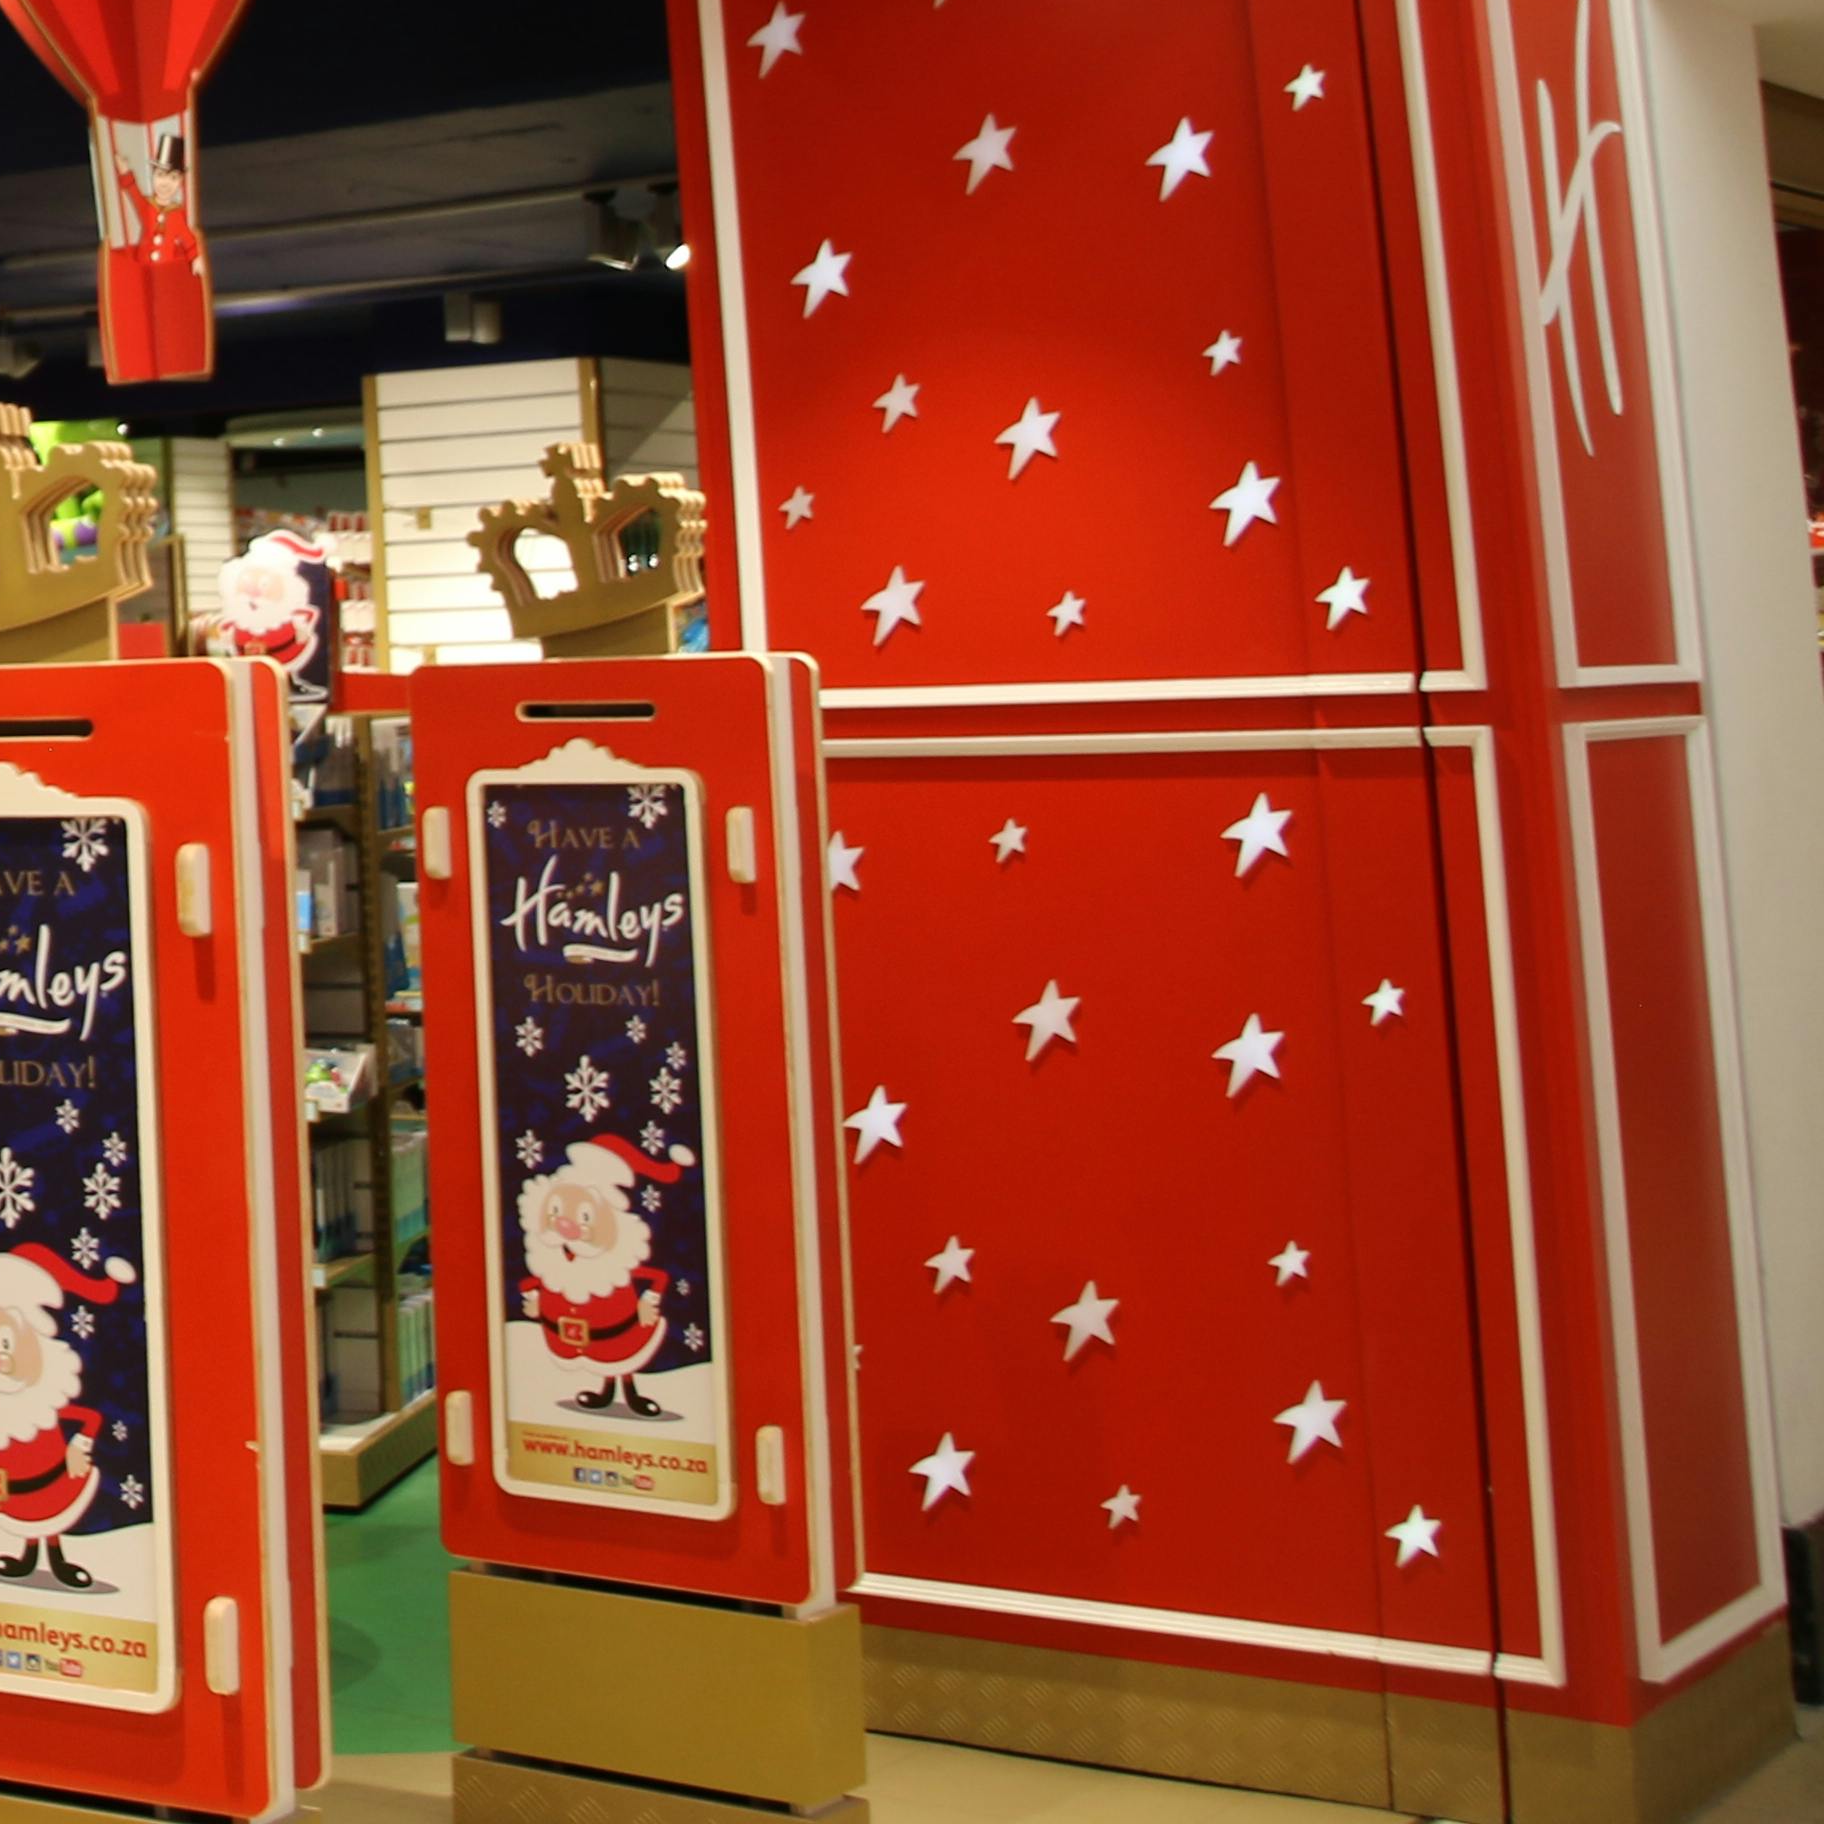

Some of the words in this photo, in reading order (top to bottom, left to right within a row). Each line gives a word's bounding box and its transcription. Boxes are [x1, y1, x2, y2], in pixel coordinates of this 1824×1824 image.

[53, 869, 77, 897] A
[501, 854, 684, 967] Hamleys
[523, 1437, 709, 1475] www.hamleys.co.za
